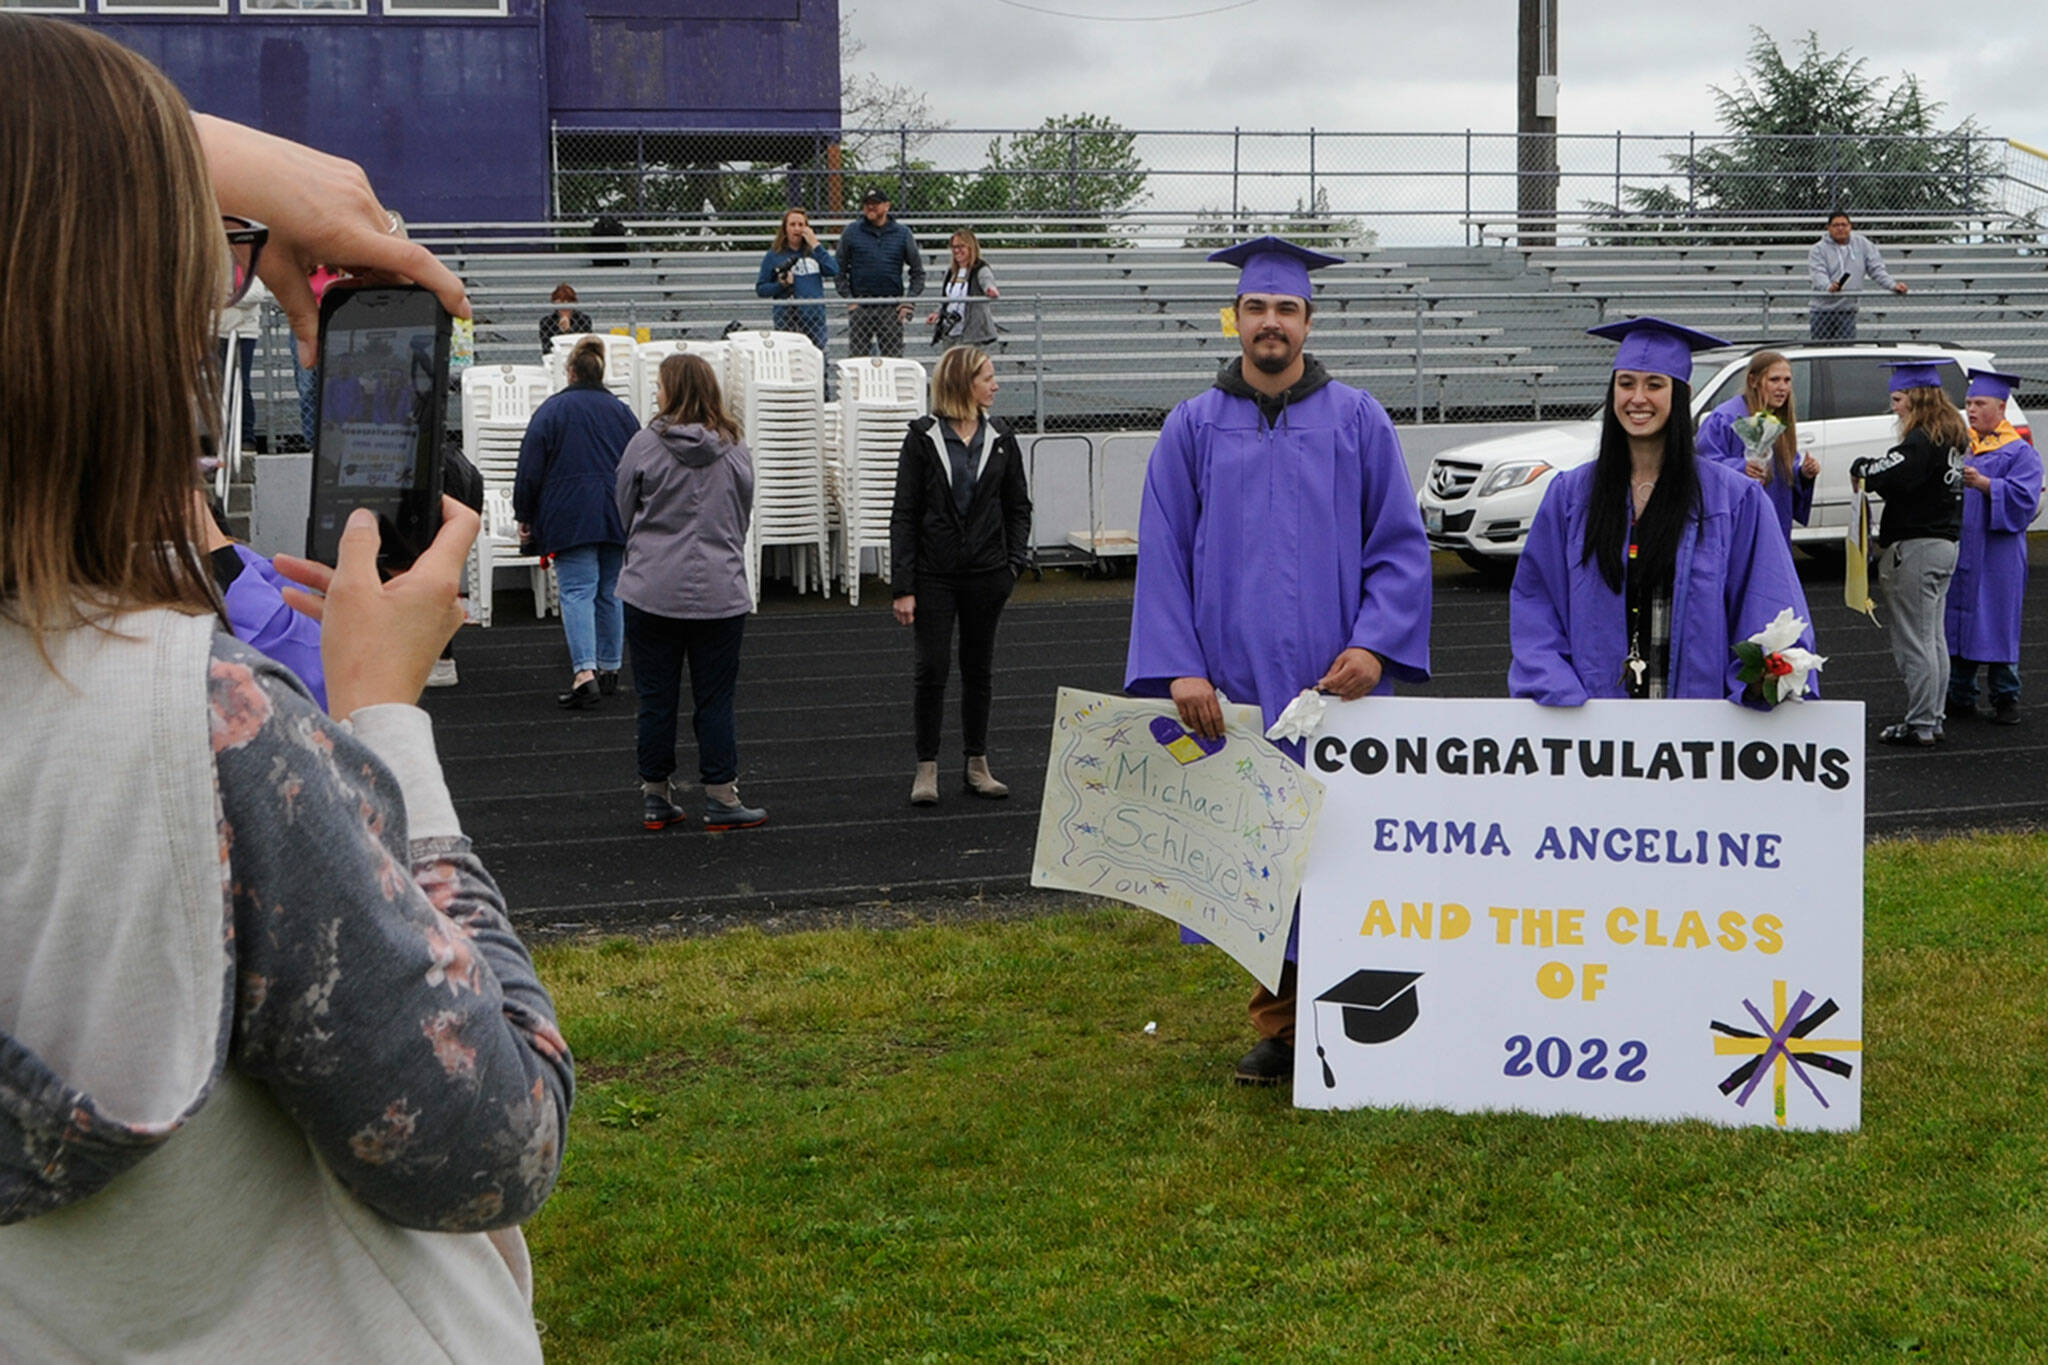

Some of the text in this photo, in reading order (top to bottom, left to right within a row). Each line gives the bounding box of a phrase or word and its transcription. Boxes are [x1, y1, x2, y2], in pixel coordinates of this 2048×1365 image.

[1313, 736, 1850, 790] CONGRATULATIONS
[1113, 751, 1244, 833] Michael
[1374, 818, 1782, 869] EMMA ANGELINE
[1359, 899, 1784, 955] AND THE CLASS
[1536, 961, 1609, 1002] OF
[1503, 1035, 1648, 1082] 2022
